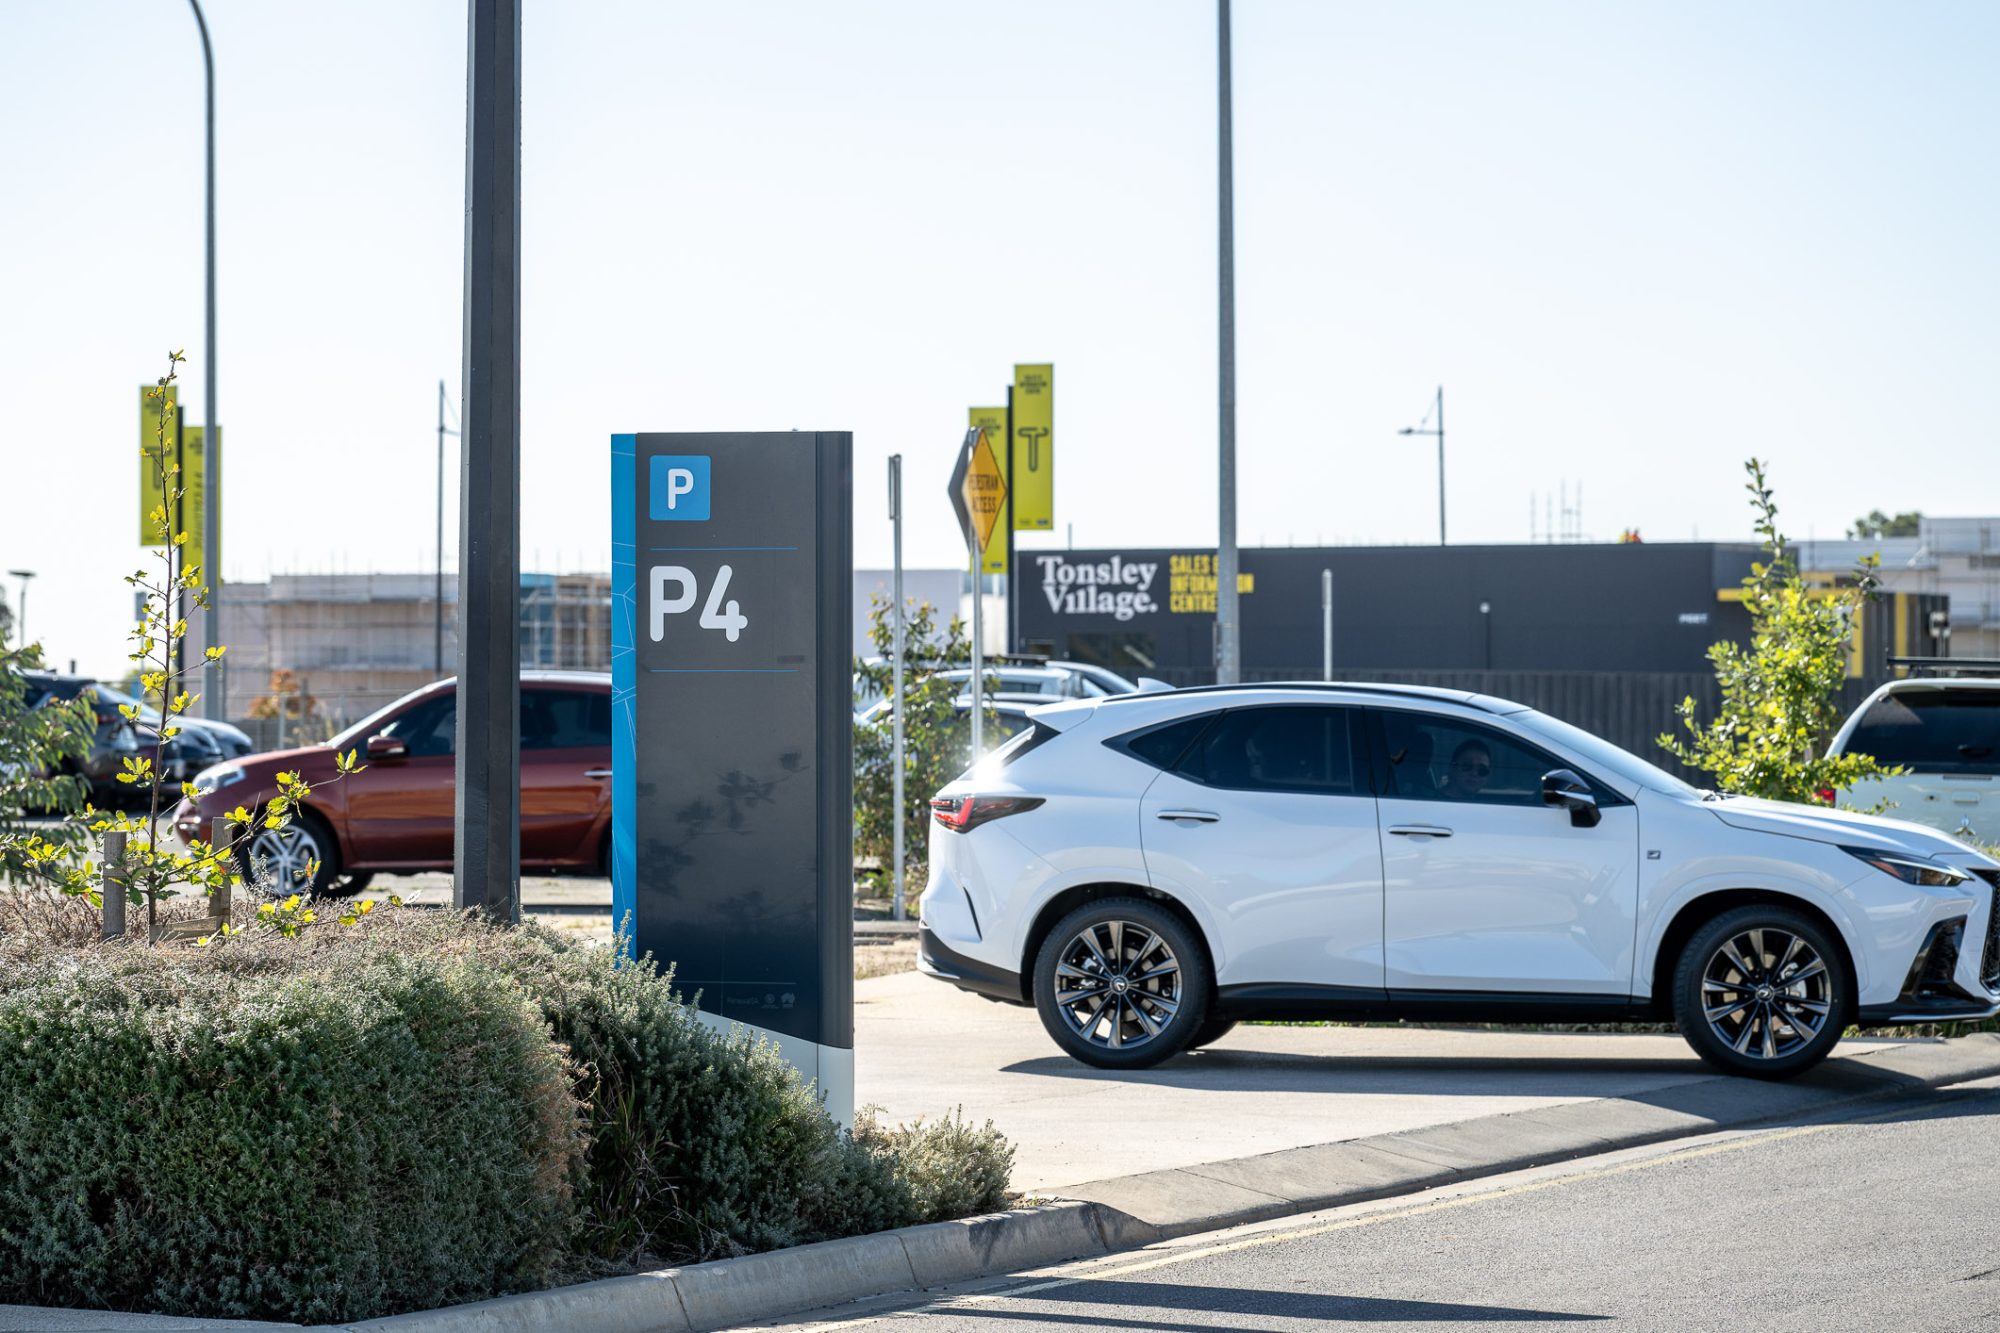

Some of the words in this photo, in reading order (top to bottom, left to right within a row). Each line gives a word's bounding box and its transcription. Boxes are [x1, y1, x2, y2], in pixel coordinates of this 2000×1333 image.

[668, 468, 694, 510] P
[1036, 555, 1158, 591] Tonsley
[1169, 555, 1210, 574] SALES
[1170, 574, 1254, 593] INFORMON
[650, 565, 748, 642] P4
[1043, 585, 1158, 621] Village.
[1170, 594, 1217, 613] CENTRE
